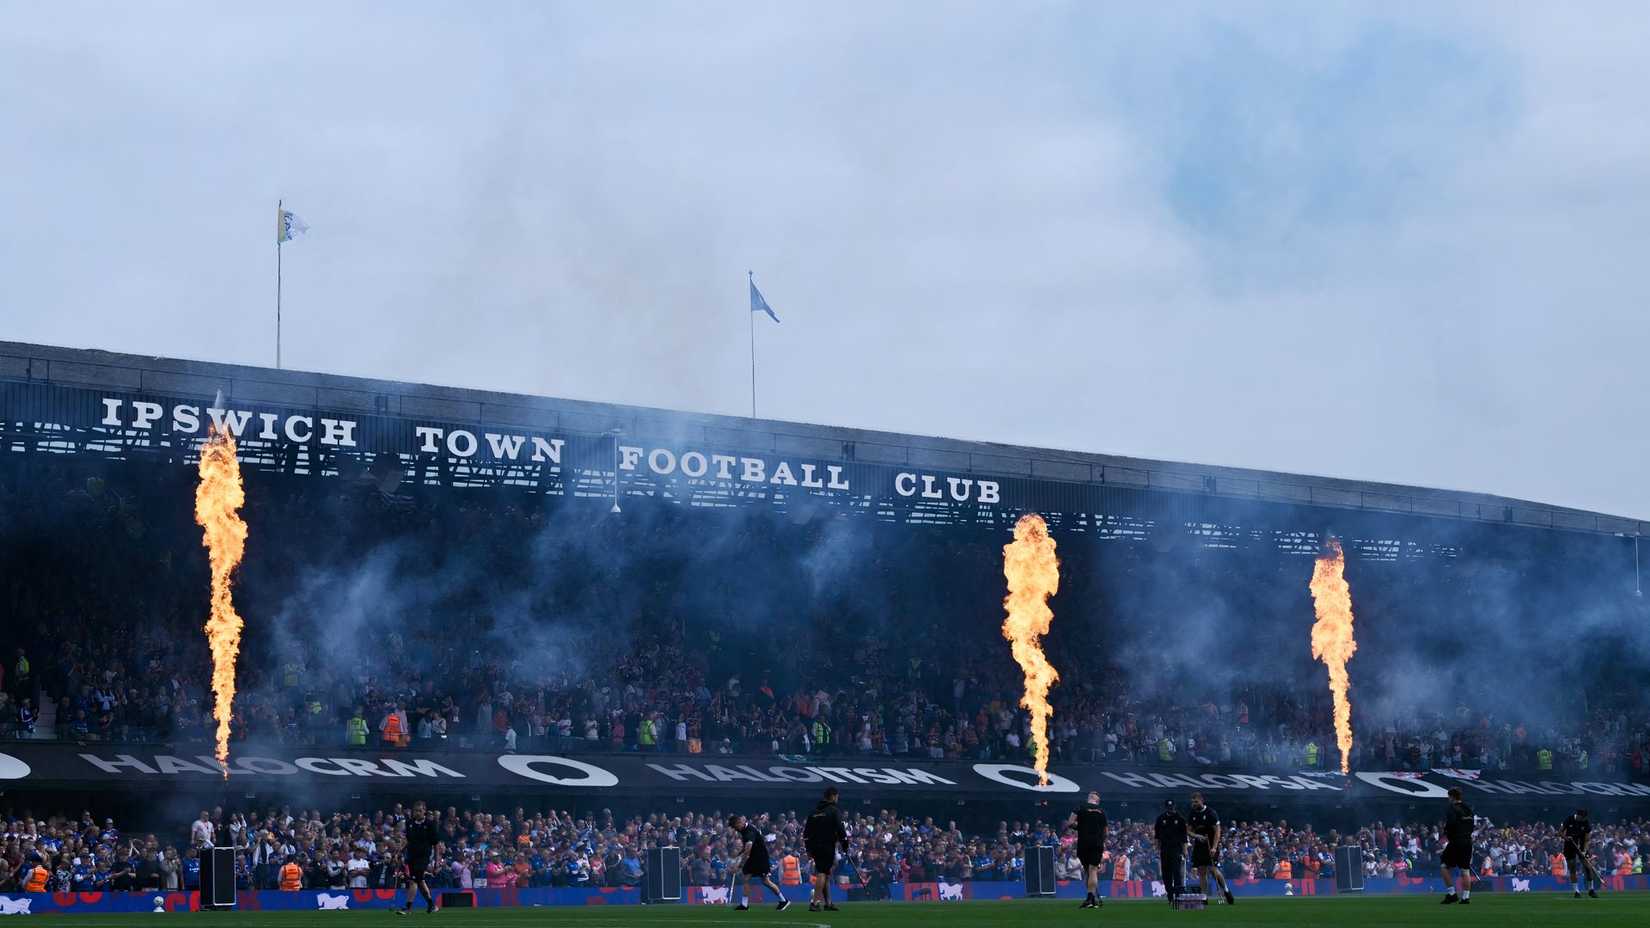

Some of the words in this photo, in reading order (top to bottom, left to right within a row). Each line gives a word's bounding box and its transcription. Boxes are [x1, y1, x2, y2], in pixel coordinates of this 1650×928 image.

[102, 398, 357, 447] IPSWICH
[416, 426, 565, 464] TOWN
[618, 446, 849, 490] FOOTBALL
[895, 473, 1001, 504] CLUB
